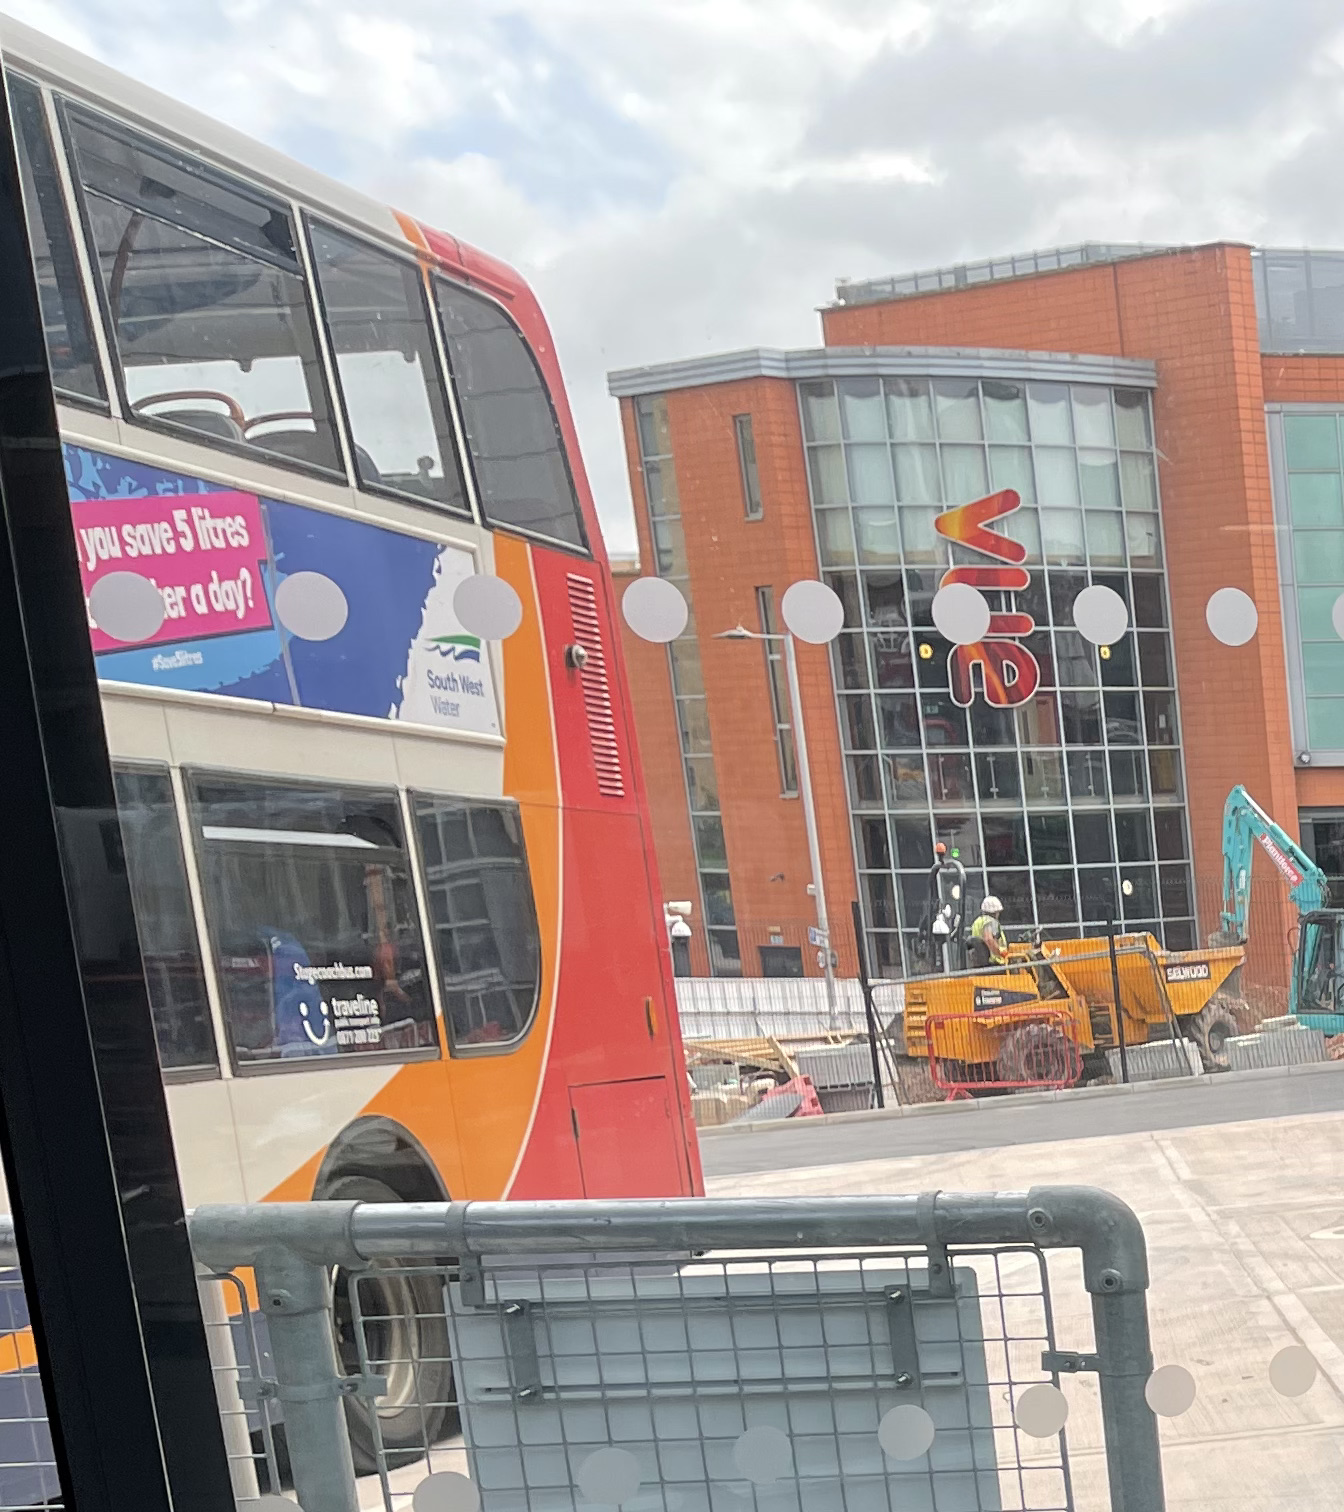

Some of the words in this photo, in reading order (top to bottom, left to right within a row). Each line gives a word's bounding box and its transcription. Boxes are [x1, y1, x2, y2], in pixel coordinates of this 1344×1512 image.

[79, 526, 122, 572] you
[122, 521, 176, 557] save
[172, 509, 194, 552] 5
[191, 506, 250, 551] litres
[190, 583, 208, 615] a
[208, 567, 254, 619] day?
[427, 669, 459, 692] South
[459, 674, 485, 697] West
[430, 695, 460, 717] Water
[331, 994, 379, 1017] traveline
